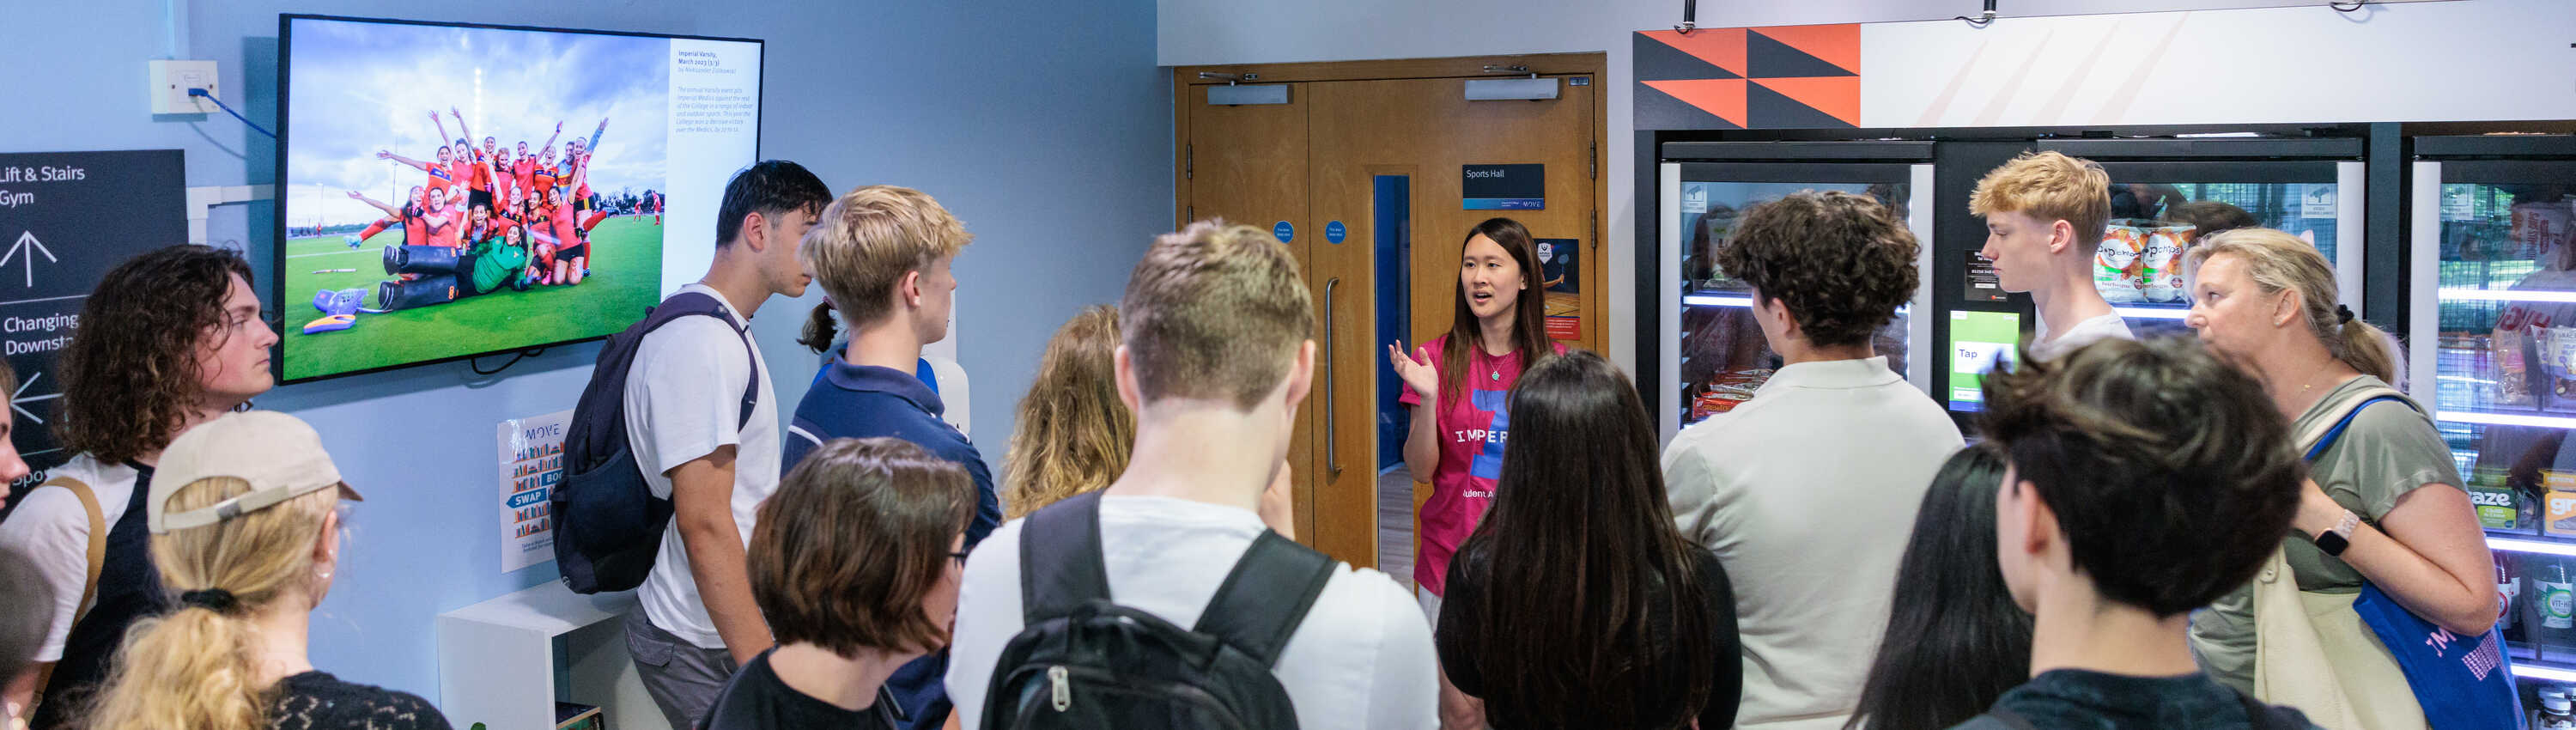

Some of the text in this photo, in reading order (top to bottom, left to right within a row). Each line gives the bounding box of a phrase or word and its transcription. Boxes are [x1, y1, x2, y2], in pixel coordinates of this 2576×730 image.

[25, 167, 39, 182] &
[41, 165, 85, 181] Stairs
[1466, 168, 1504, 179] Sports Hall
[0, 190, 34, 208] Gym
[3, 312, 80, 333] Changing
[1959, 349, 1978, 361] Tap
[526, 423, 561, 441] MOVE
[515, 491, 542, 506] SWAP
